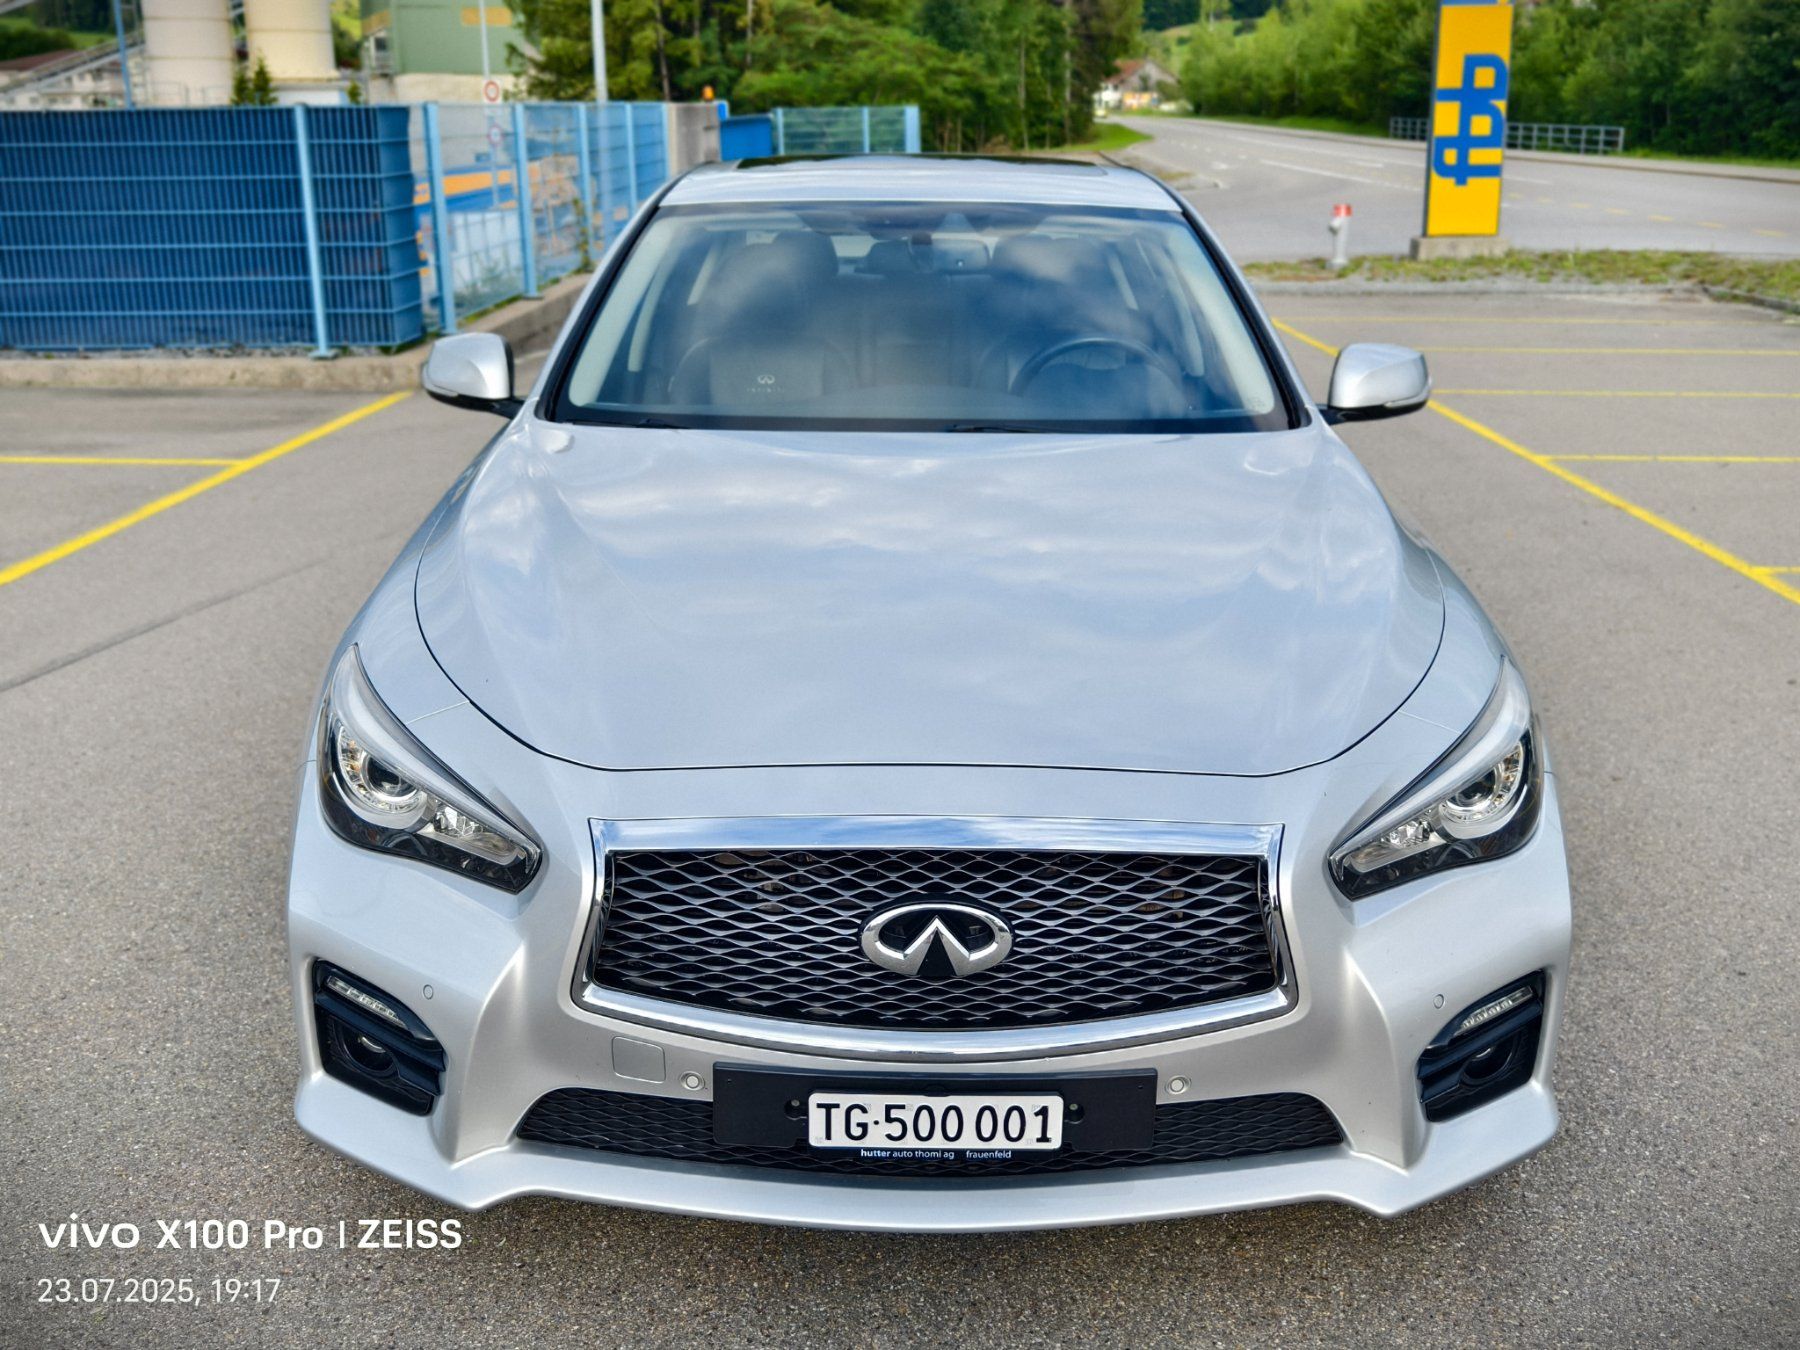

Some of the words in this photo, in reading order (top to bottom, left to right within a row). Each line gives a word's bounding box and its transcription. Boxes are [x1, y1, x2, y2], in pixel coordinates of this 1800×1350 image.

[861, 1149, 891, 1157] hutter
[892, 1150, 913, 1158] auto
[943, 1151, 955, 1160] ag
[966, 1150, 1012, 1159] frauenfeld
